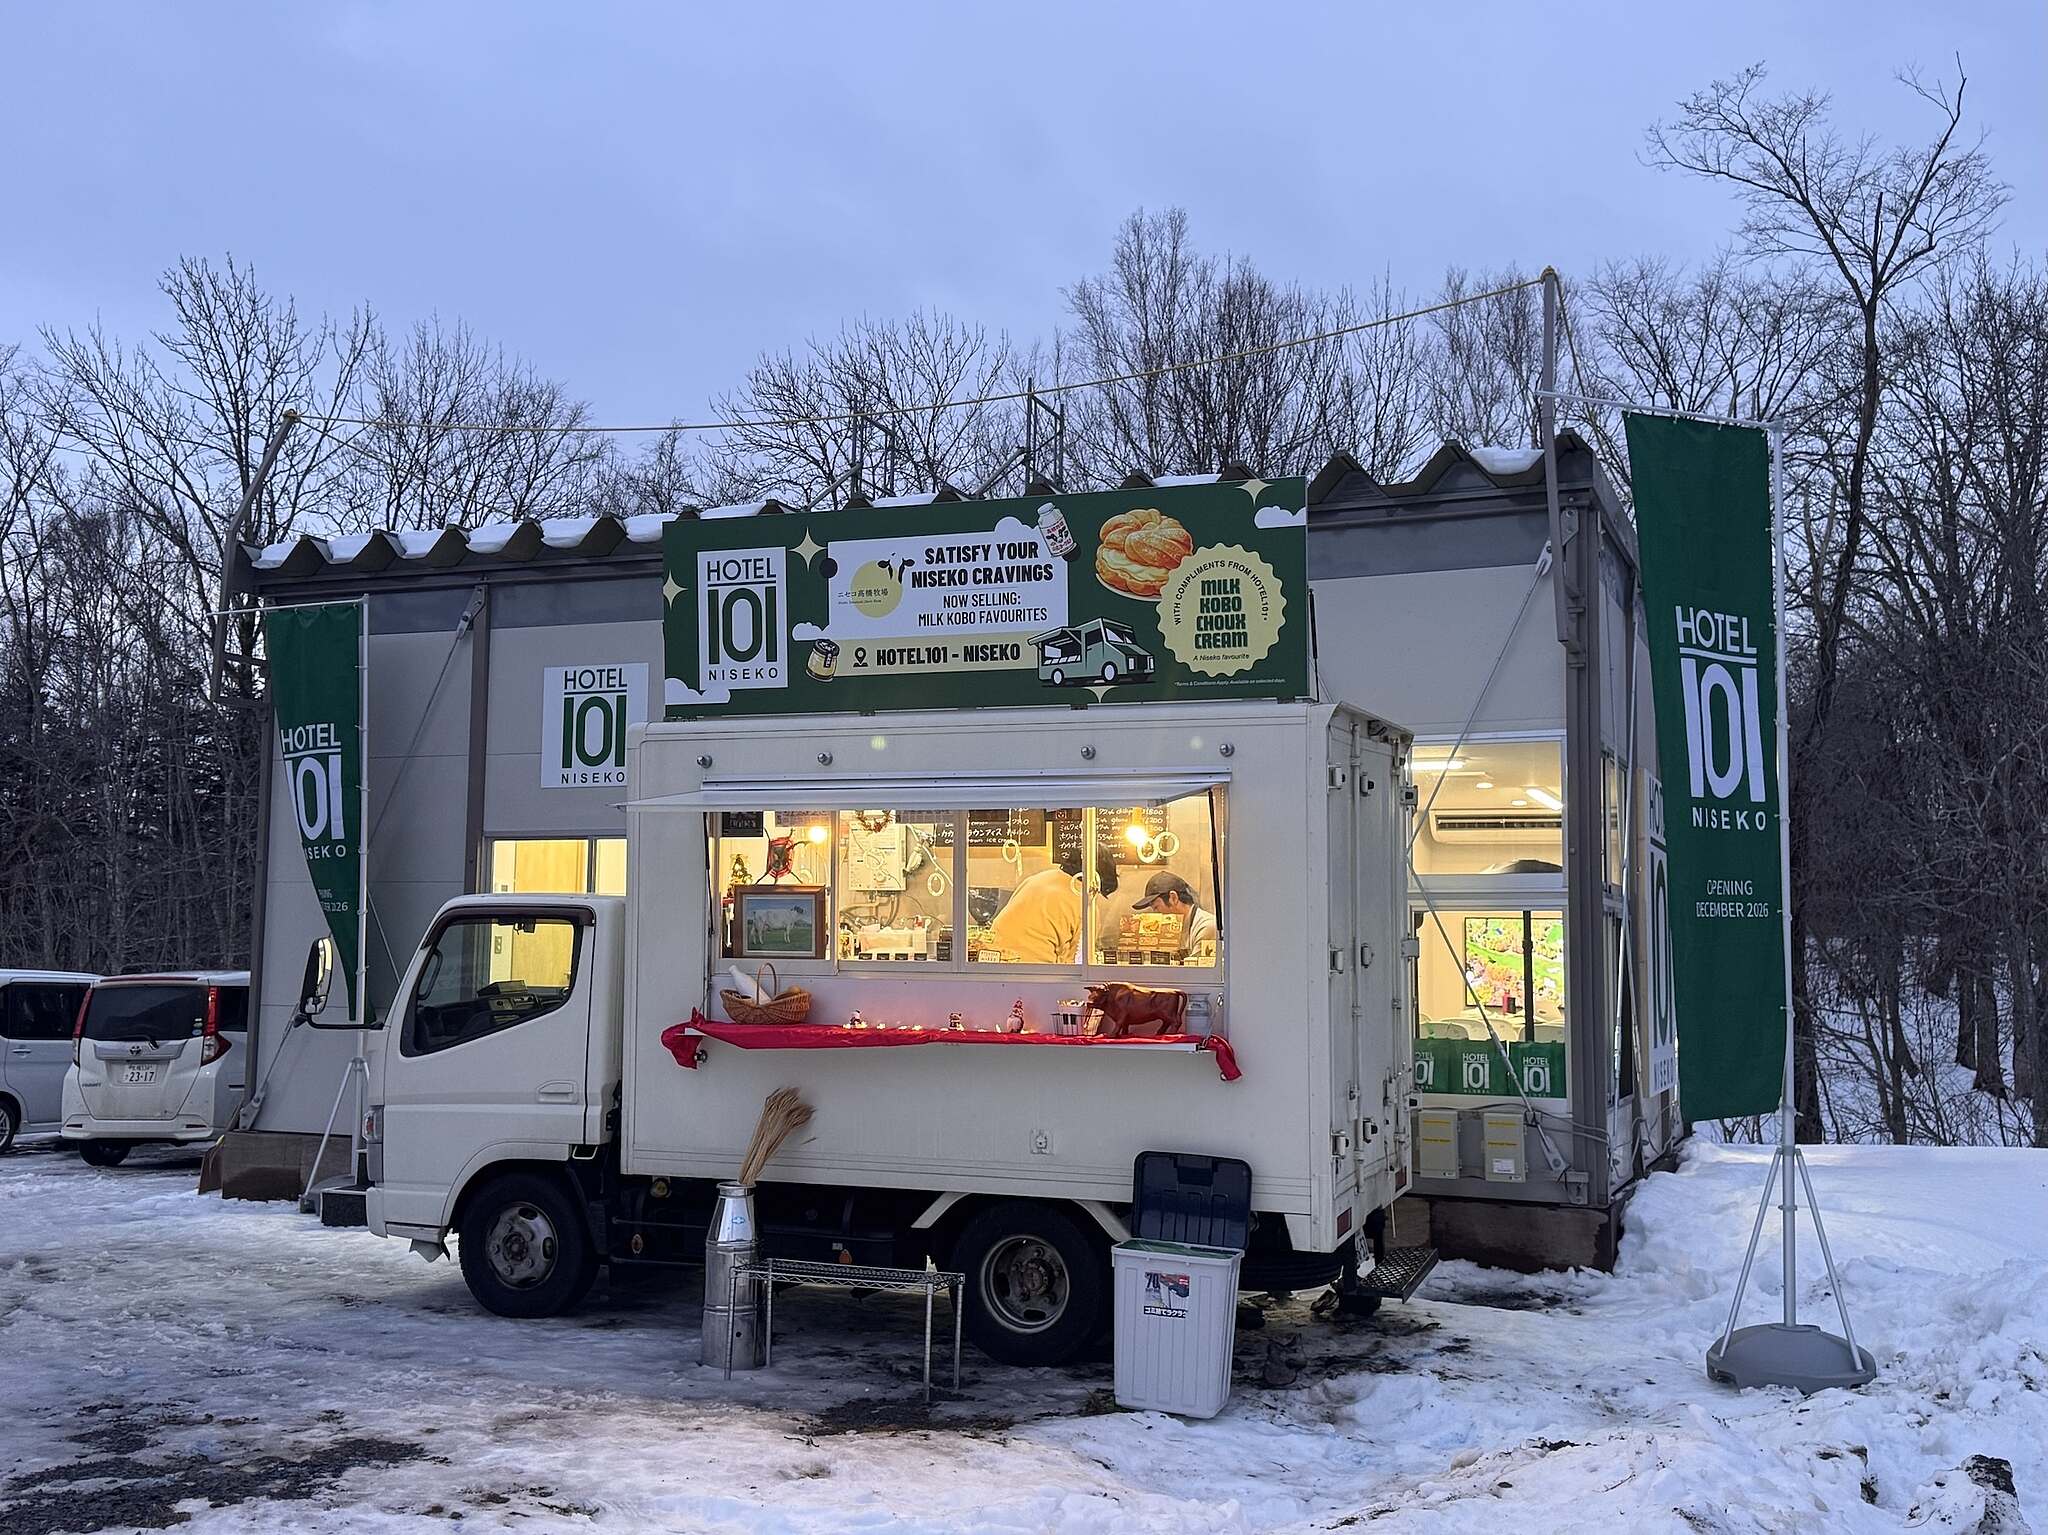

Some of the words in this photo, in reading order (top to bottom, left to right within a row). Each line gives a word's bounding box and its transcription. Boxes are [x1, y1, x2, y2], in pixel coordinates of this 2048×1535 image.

[925, 544, 991, 565] SATISFY
[996, 541, 1039, 561] YOUR
[706, 557, 777, 581] HOTEL
[911, 568, 968, 589] NISEKO
[972, 564, 1053, 585] CRAVINGS
[1228, 561, 1252, 576] FROM
[1175, 560, 1226, 600] COMPLIMENTS
[1201, 578, 1240, 596] MILK
[943, 594, 968, 609] NOW
[971, 592, 1021, 608] SELLING:
[1200, 596, 1242, 614] KOBO
[918, 613, 944, 627] MILK
[947, 611, 976, 626] KOBO
[979, 608, 1047, 625] FAVOURITES
[1173, 602, 1182, 625] WITH
[1196, 613, 1247, 631] CHOUX
[707, 585, 778, 665] 101
[1675, 605, 1757, 653] HOTEL
[1194, 631, 1248, 649] CREAM
[877, 645, 948, 666] HOTEL101
[963, 643, 1020, 663] NISEKO
[1222, 653, 1250, 661] favourite
[564, 667, 628, 690] HOTEL
[708, 667, 778, 681] NISEKO
[280, 723, 342, 752] HOTEL
[562, 694, 627, 769] 101
[1680, 657, 1765, 803] 101
[561, 771, 625, 784] NISEKO
[1692, 807, 1767, 831] NISEKO
[303, 845, 346, 861] ISEKO
[1706, 880, 1753, 896] OPENING
[1695, 902, 1745, 917] DECEMBER
[1747, 902, 1769, 917] 2026
[1462, 1053, 1489, 1061] HOTEL
[1523, 1056, 1549, 1065] HOTEL
[1462, 1061, 1490, 1089] 101
[1523, 1065, 1551, 1093] 101
